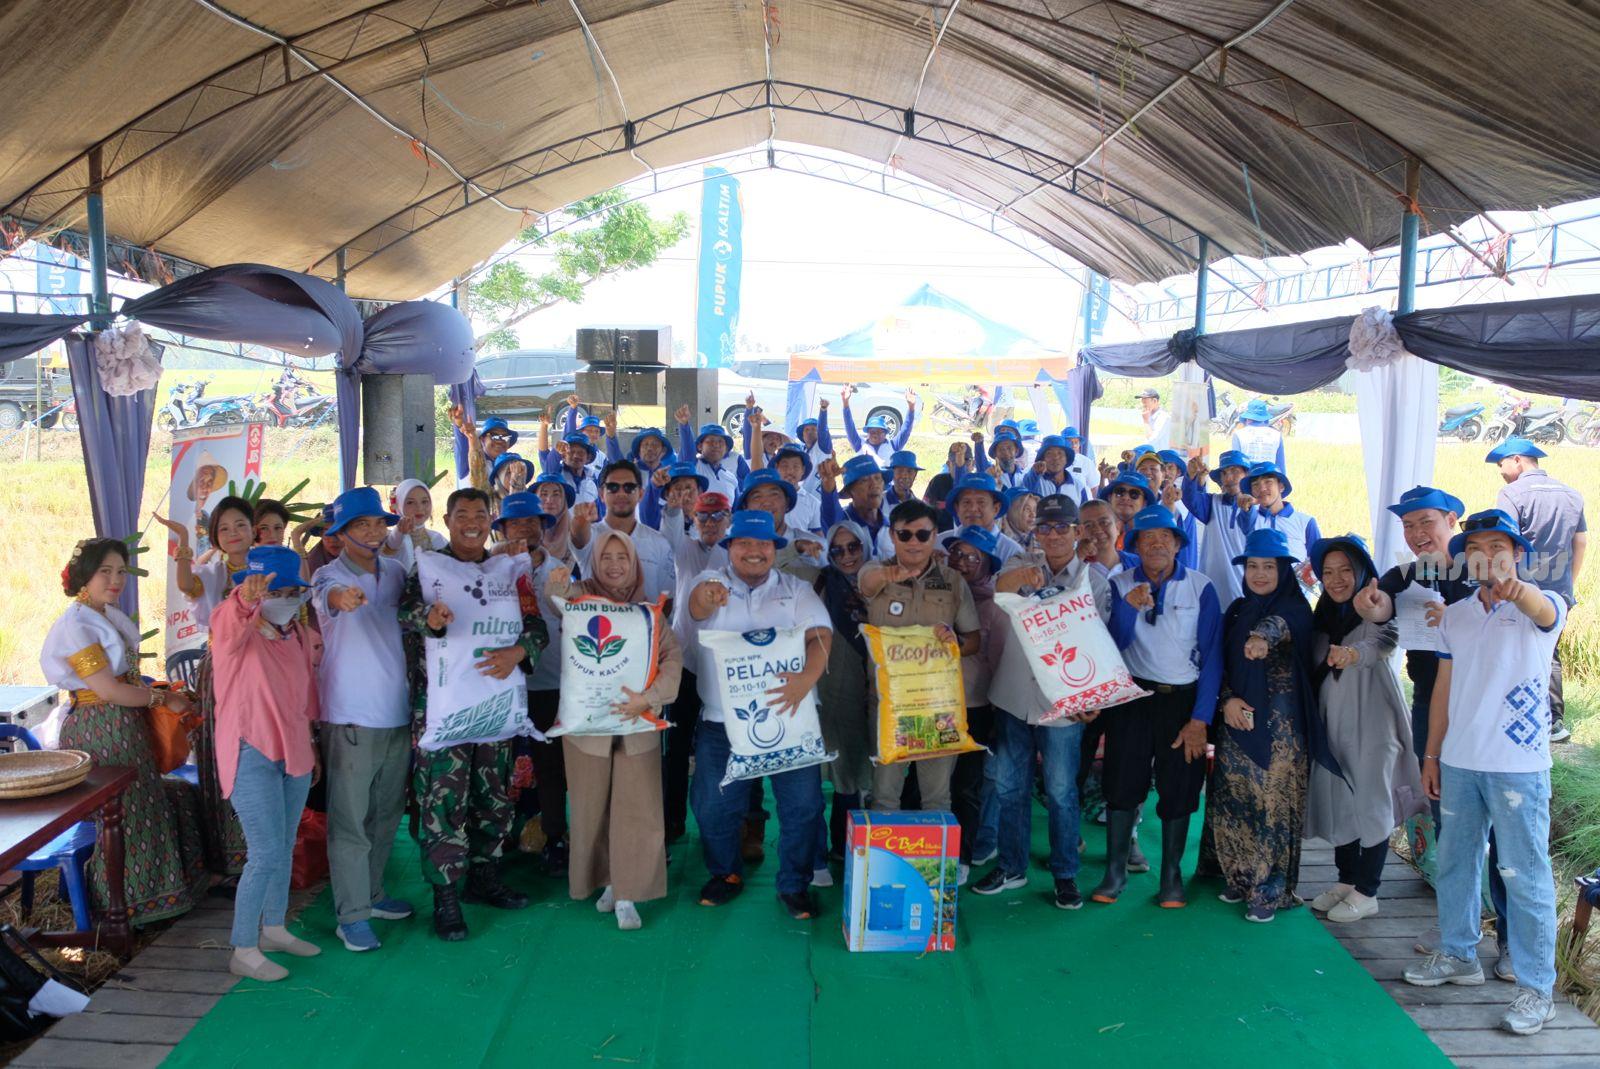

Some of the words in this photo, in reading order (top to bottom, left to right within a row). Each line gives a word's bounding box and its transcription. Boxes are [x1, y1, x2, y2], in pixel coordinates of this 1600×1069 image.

[718, 184, 731, 238] KALTIM
[714, 263, 727, 316] PUPUK
[1023, 594, 1094, 632] PELANG
[569, 655, 595, 676] PUPUK
[600, 656, 630, 676] KALTIM
[726, 655, 805, 681] PELANGI
[729, 680, 767, 693] 20-10-10
